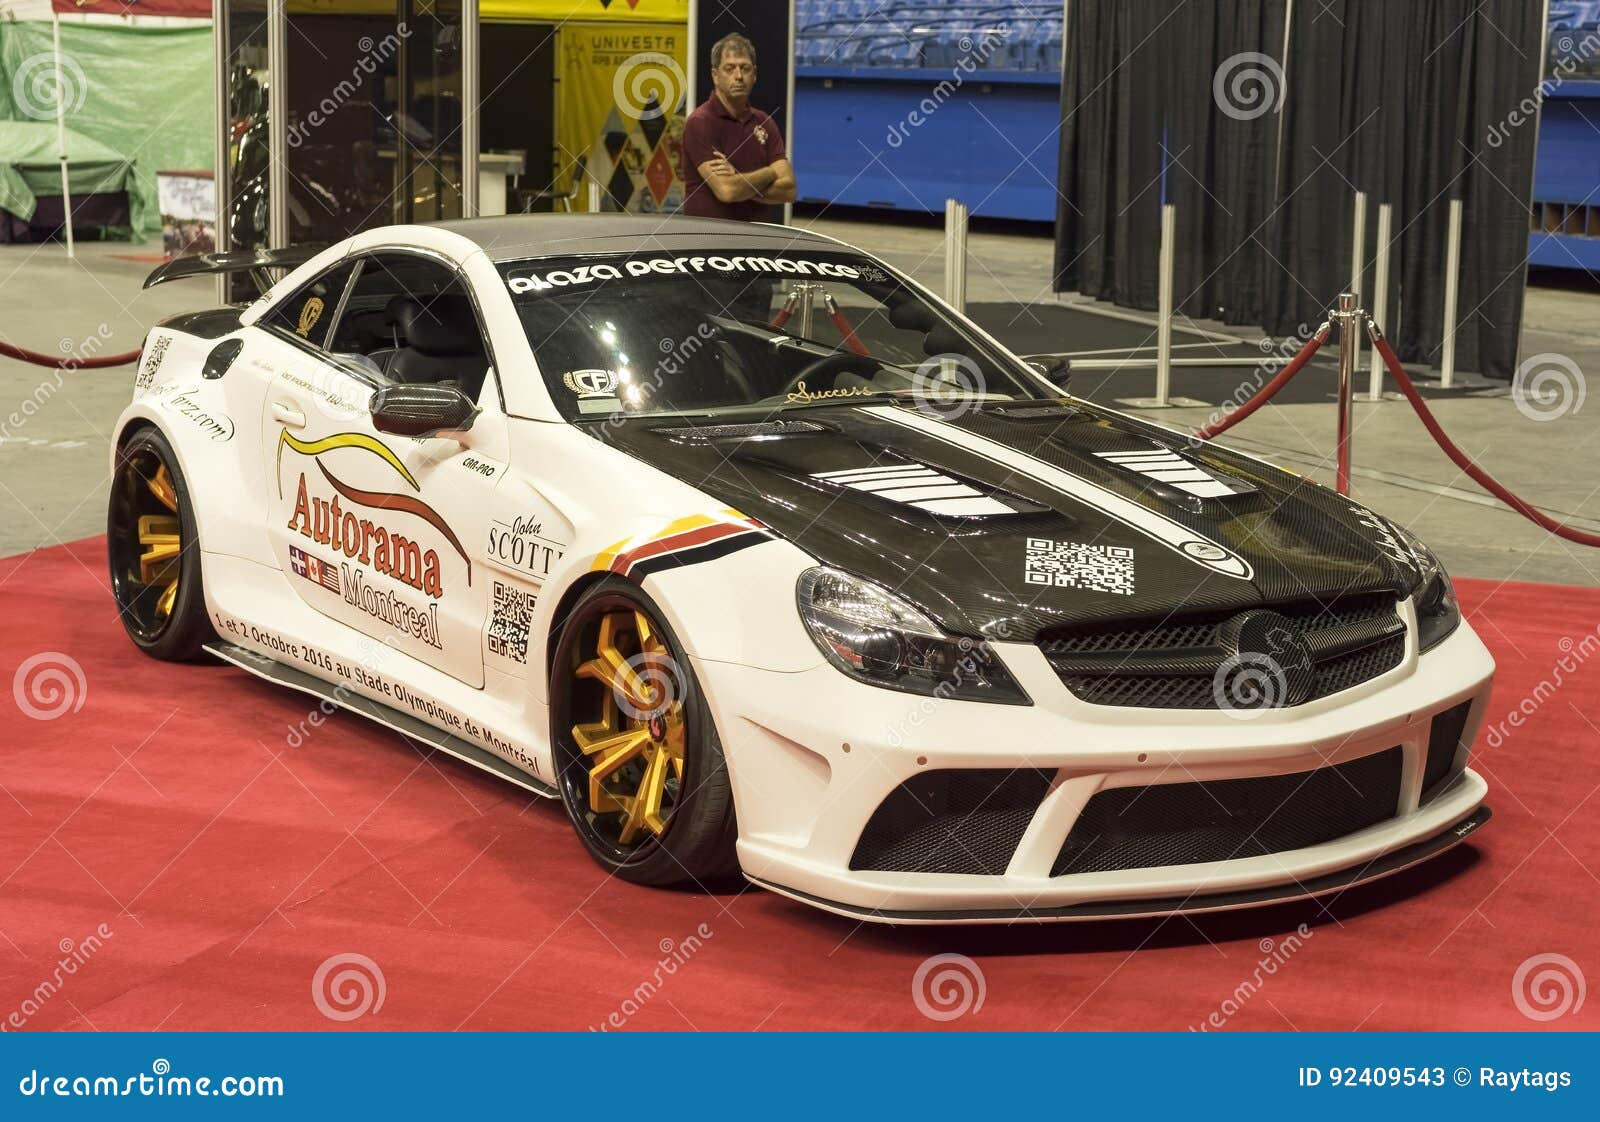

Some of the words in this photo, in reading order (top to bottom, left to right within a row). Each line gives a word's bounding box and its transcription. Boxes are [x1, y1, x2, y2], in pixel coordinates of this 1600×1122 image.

[591, 35, 676, 50] UNIVESTA
[508, 264, 623, 294] plaza
[625, 256, 860, 279] performance
[783, 381, 873, 404] Success
[462, 457, 495, 477] CAR-PRO
[287, 472, 443, 599] Autorama
[510, 514, 542, 545] John
[487, 527, 565, 575] SCOTT
[341, 562, 443, 650] Montreal
[215, 613, 224, 628] 1
[226, 618, 240, 635] et
[240, 622, 249, 638] 2
[251, 626, 299, 659] Octobre
[301, 645, 333, 671] 2016
[336, 662, 351, 679] au
[354, 667, 391, 697] Stade
[393, 684, 462, 730] Olympique
[464, 718, 480, 739] de
[483, 727, 541, 777] Montréal
